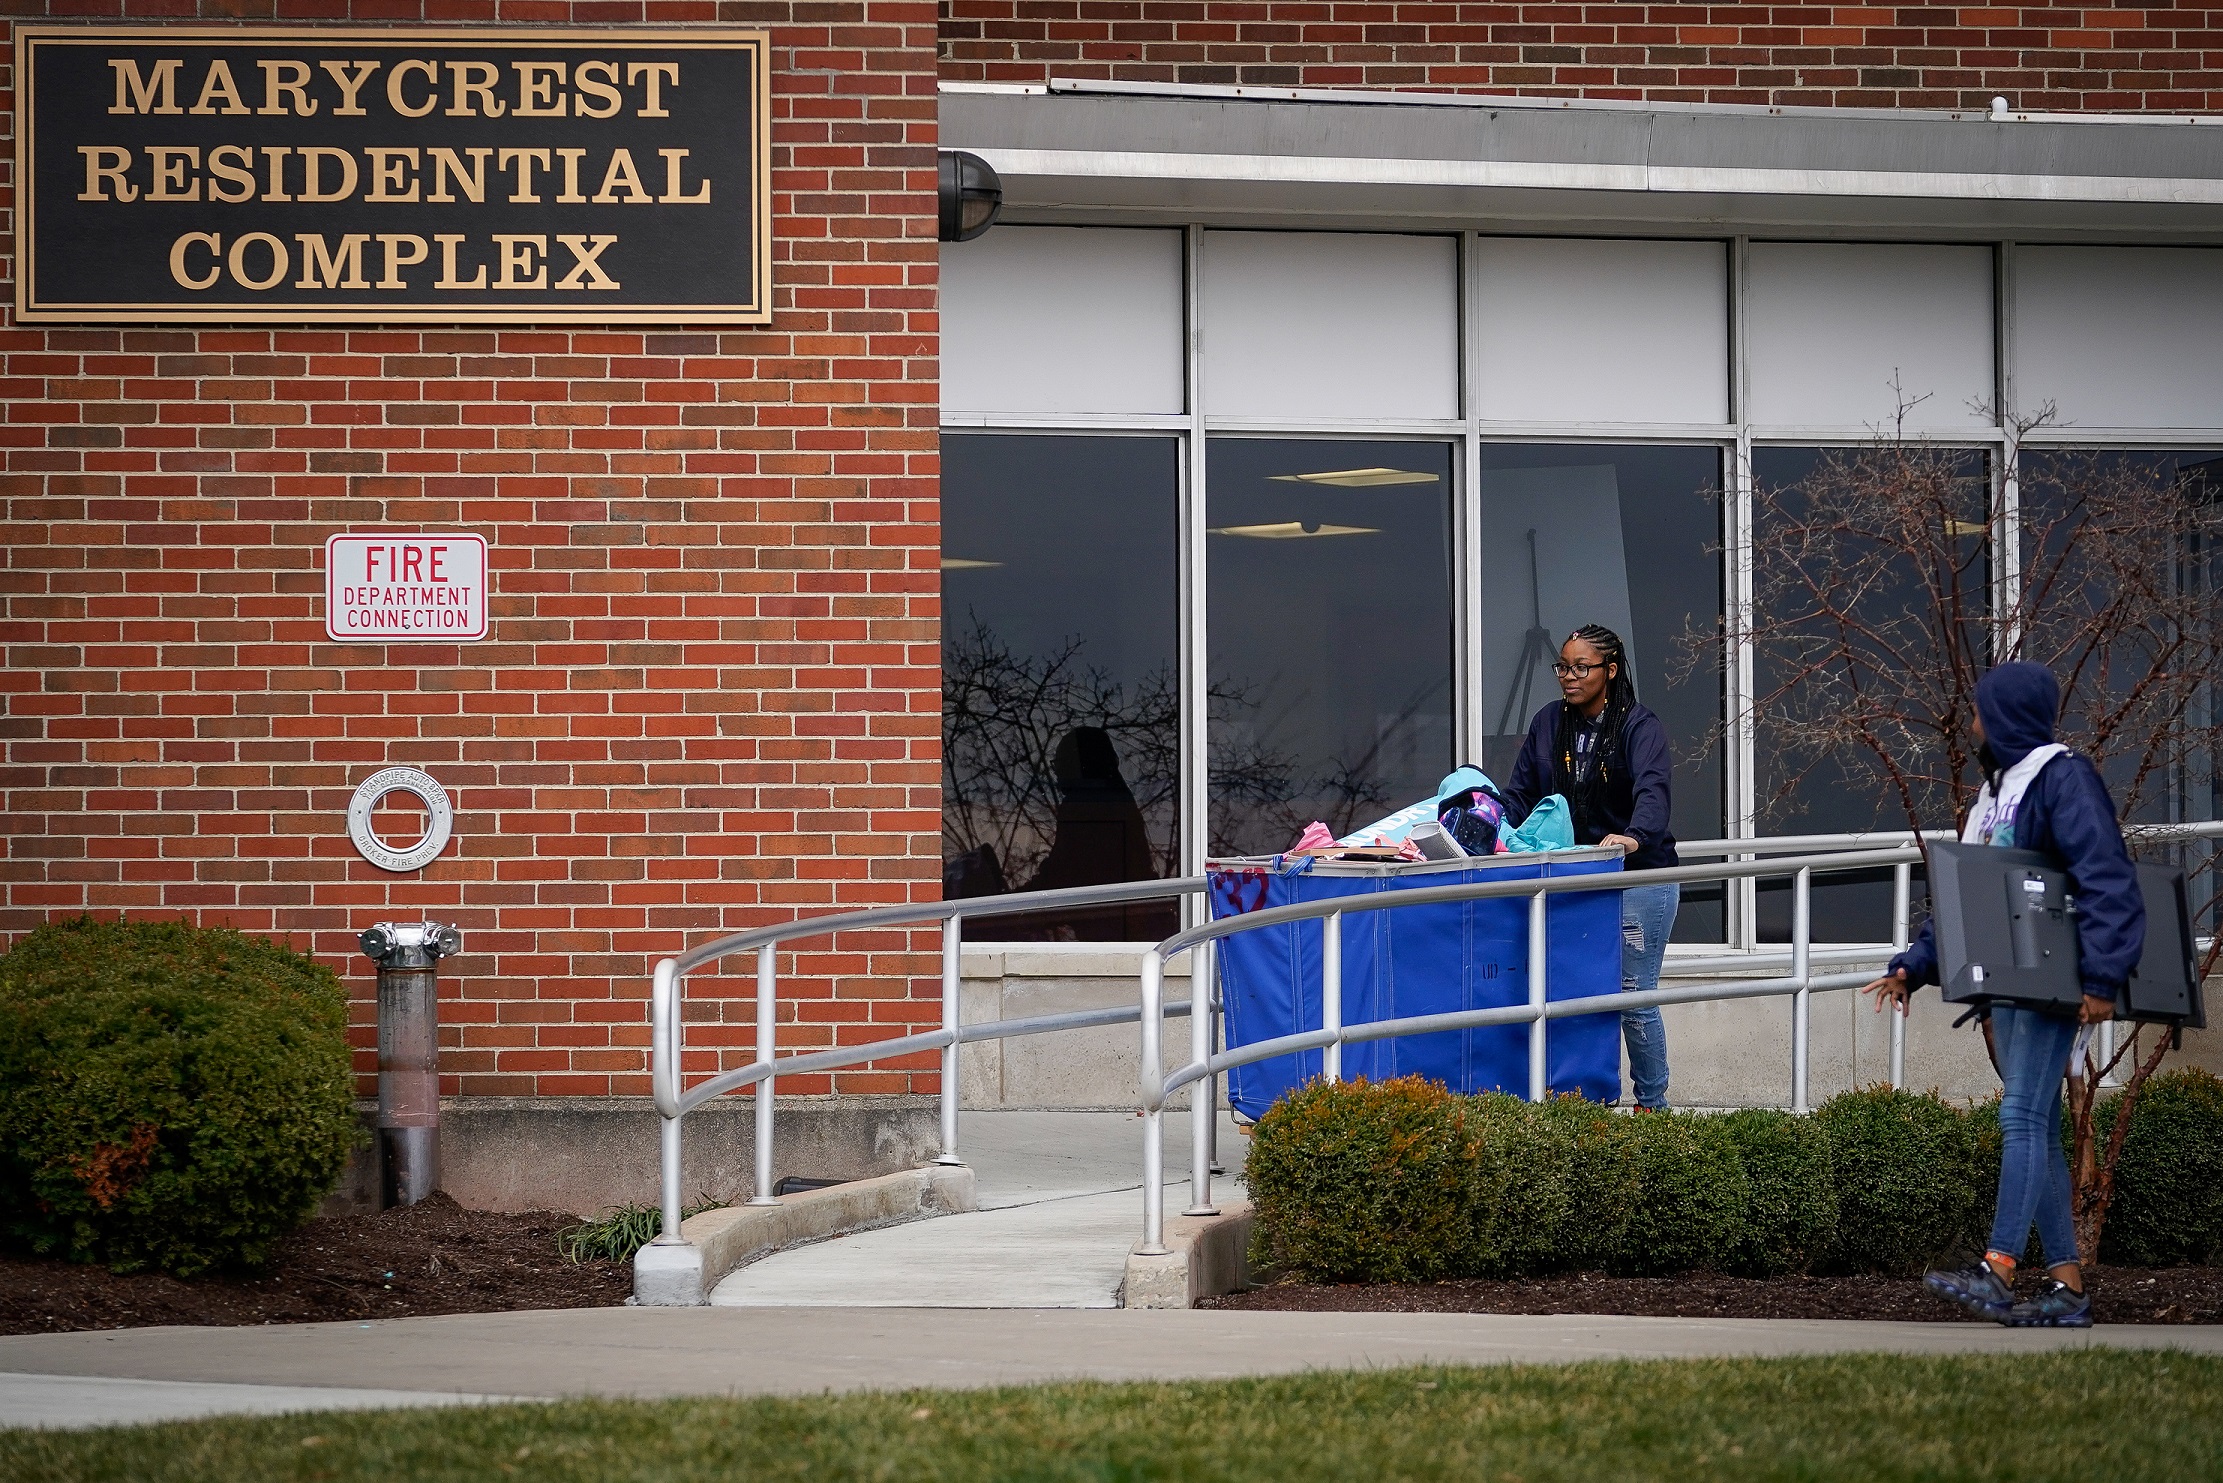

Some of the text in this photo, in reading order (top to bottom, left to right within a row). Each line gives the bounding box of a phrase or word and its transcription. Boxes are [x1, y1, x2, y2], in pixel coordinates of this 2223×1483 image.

[107, 58, 680, 118] MARYCREST
[76, 145, 712, 204] RESIDENTIAL
[169, 231, 621, 291] COMPLEX
[366, 546, 448, 582] FIRE
[344, 587, 471, 605] DEPARTMENT
[347, 609, 468, 628] CONNECTION
